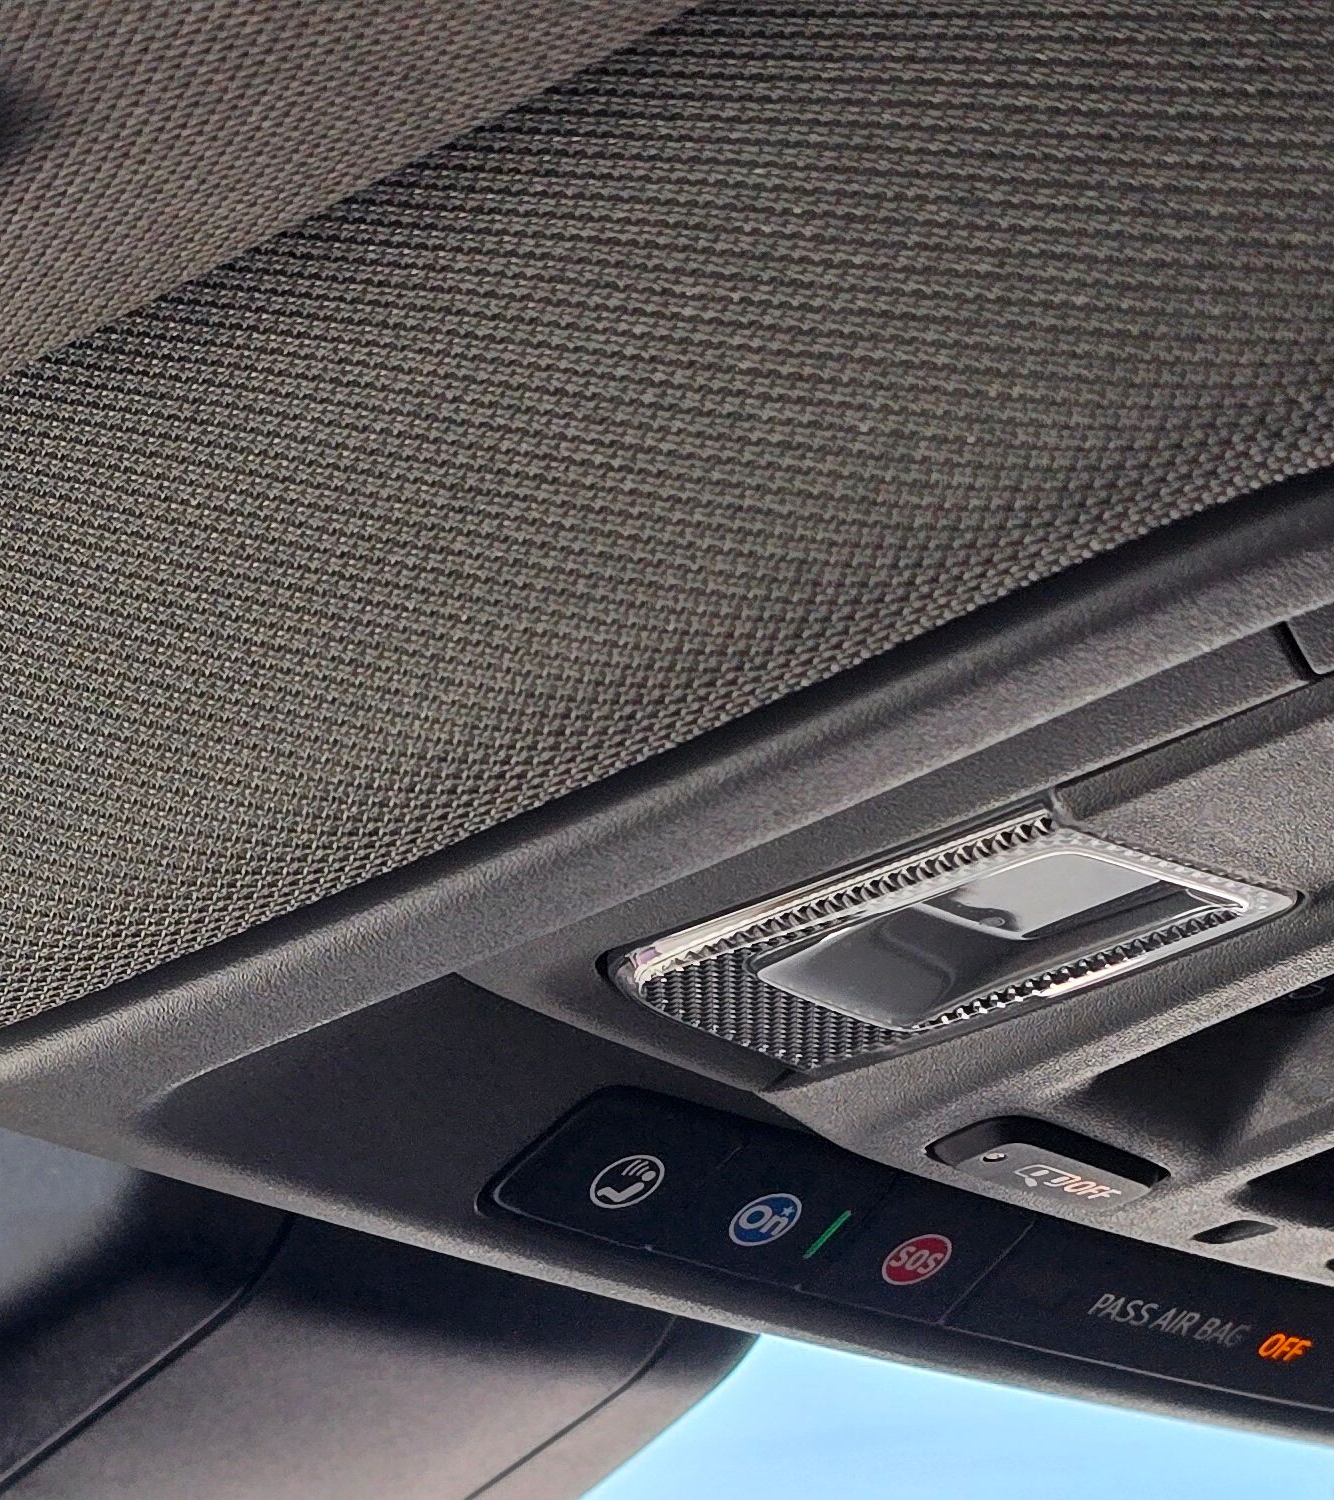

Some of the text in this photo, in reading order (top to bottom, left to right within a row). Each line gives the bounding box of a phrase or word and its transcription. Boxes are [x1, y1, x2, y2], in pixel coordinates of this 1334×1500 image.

[1064, 1181, 1121, 1199] OFF
[738, 1204, 789, 1235] On
[889, 1245, 944, 1274] SOS
[1087, 1293, 1253, 1348] PASS AIR BAG
[1258, 1332, 1314, 1361] OFF
